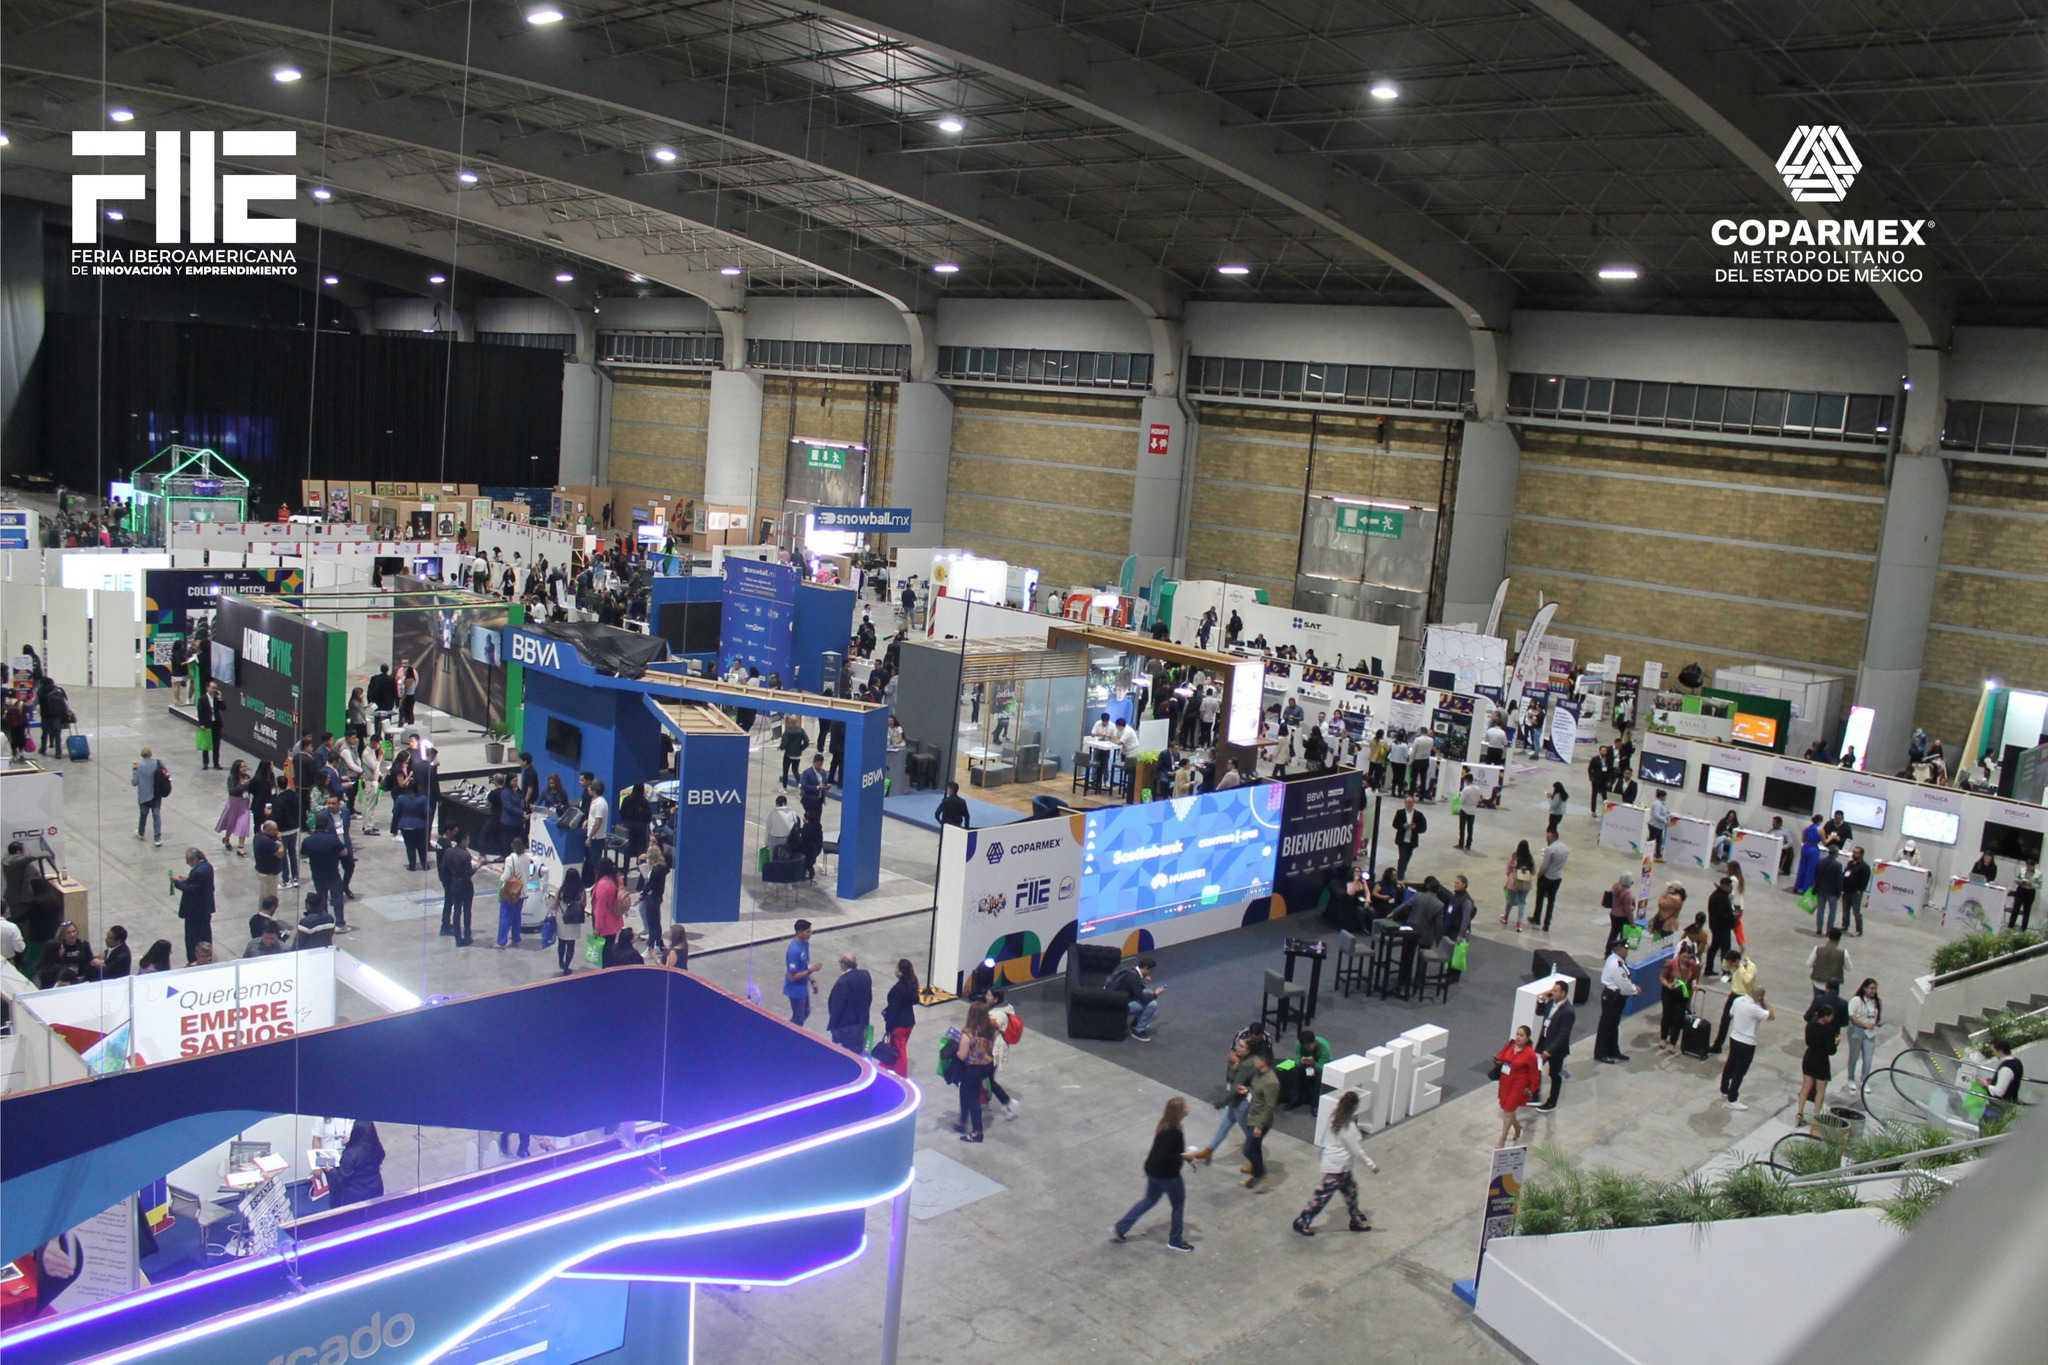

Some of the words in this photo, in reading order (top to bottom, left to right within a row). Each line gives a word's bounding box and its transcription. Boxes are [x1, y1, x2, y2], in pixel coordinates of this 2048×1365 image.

[837, 511, 909, 526] snowball.mx
[1303, 621, 1322, 630] SAT
[512, 633, 560, 670] BBVA
[862, 767, 884, 789] BBVA
[687, 788, 742, 805] BBVA
[1306, 790, 1325, 803] BBVA
[530, 839, 556, 861] BBVA
[1010, 838, 1061, 855] COPARMEX
[1281, 824, 1354, 857] BIENVENIDOS
[1112, 840, 1184, 865] Scotiabank
[1168, 868, 1206, 884] HUAWEI
[179, 979, 294, 1011] Queremos
[180, 1000, 288, 1036] EMPRE
[180, 1021, 295, 1057] SARIOS
